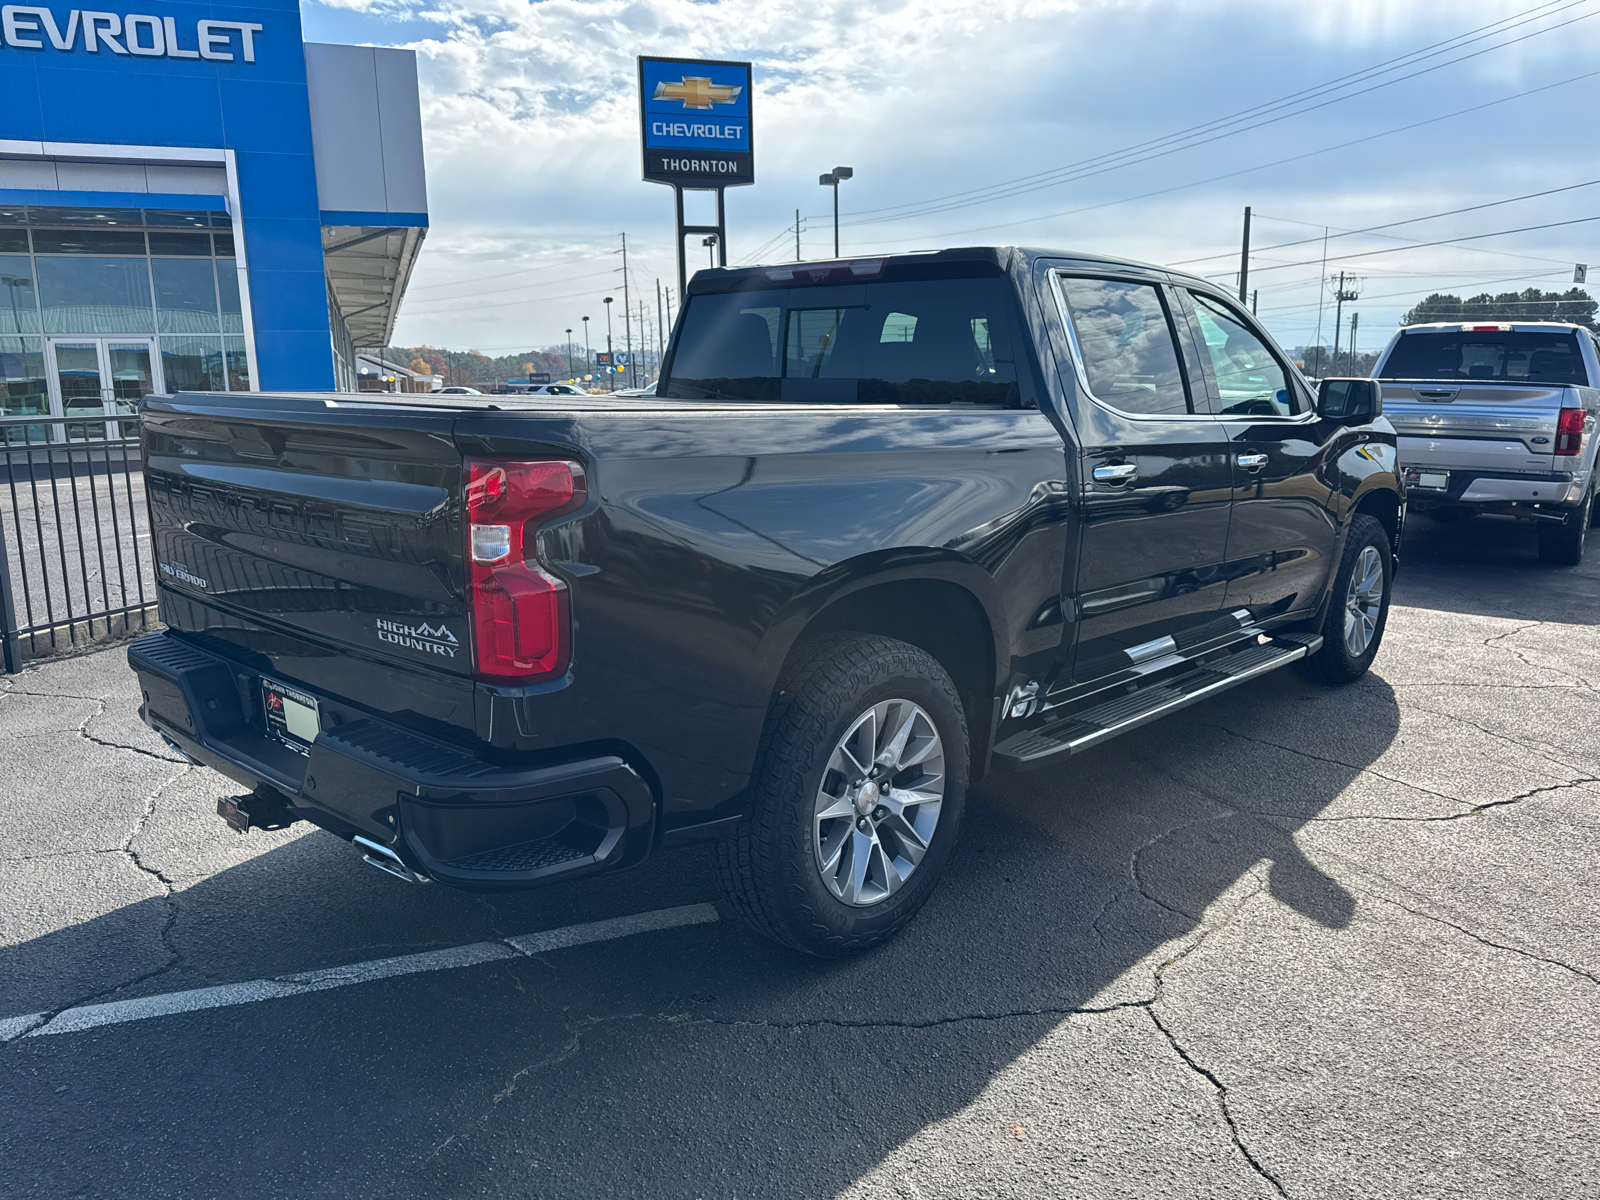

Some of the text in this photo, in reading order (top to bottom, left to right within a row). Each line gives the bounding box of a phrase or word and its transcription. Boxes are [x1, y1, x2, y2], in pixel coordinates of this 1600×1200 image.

[0, 4, 263, 63] EVROLET
[652, 122, 743, 139] CHEVROLET
[661, 158, 738, 173] THORNTON
[149, 473, 416, 553] CHEVROLET
[376, 618, 416, 637] HIGH
[378, 629, 459, 658] COUNTRY
